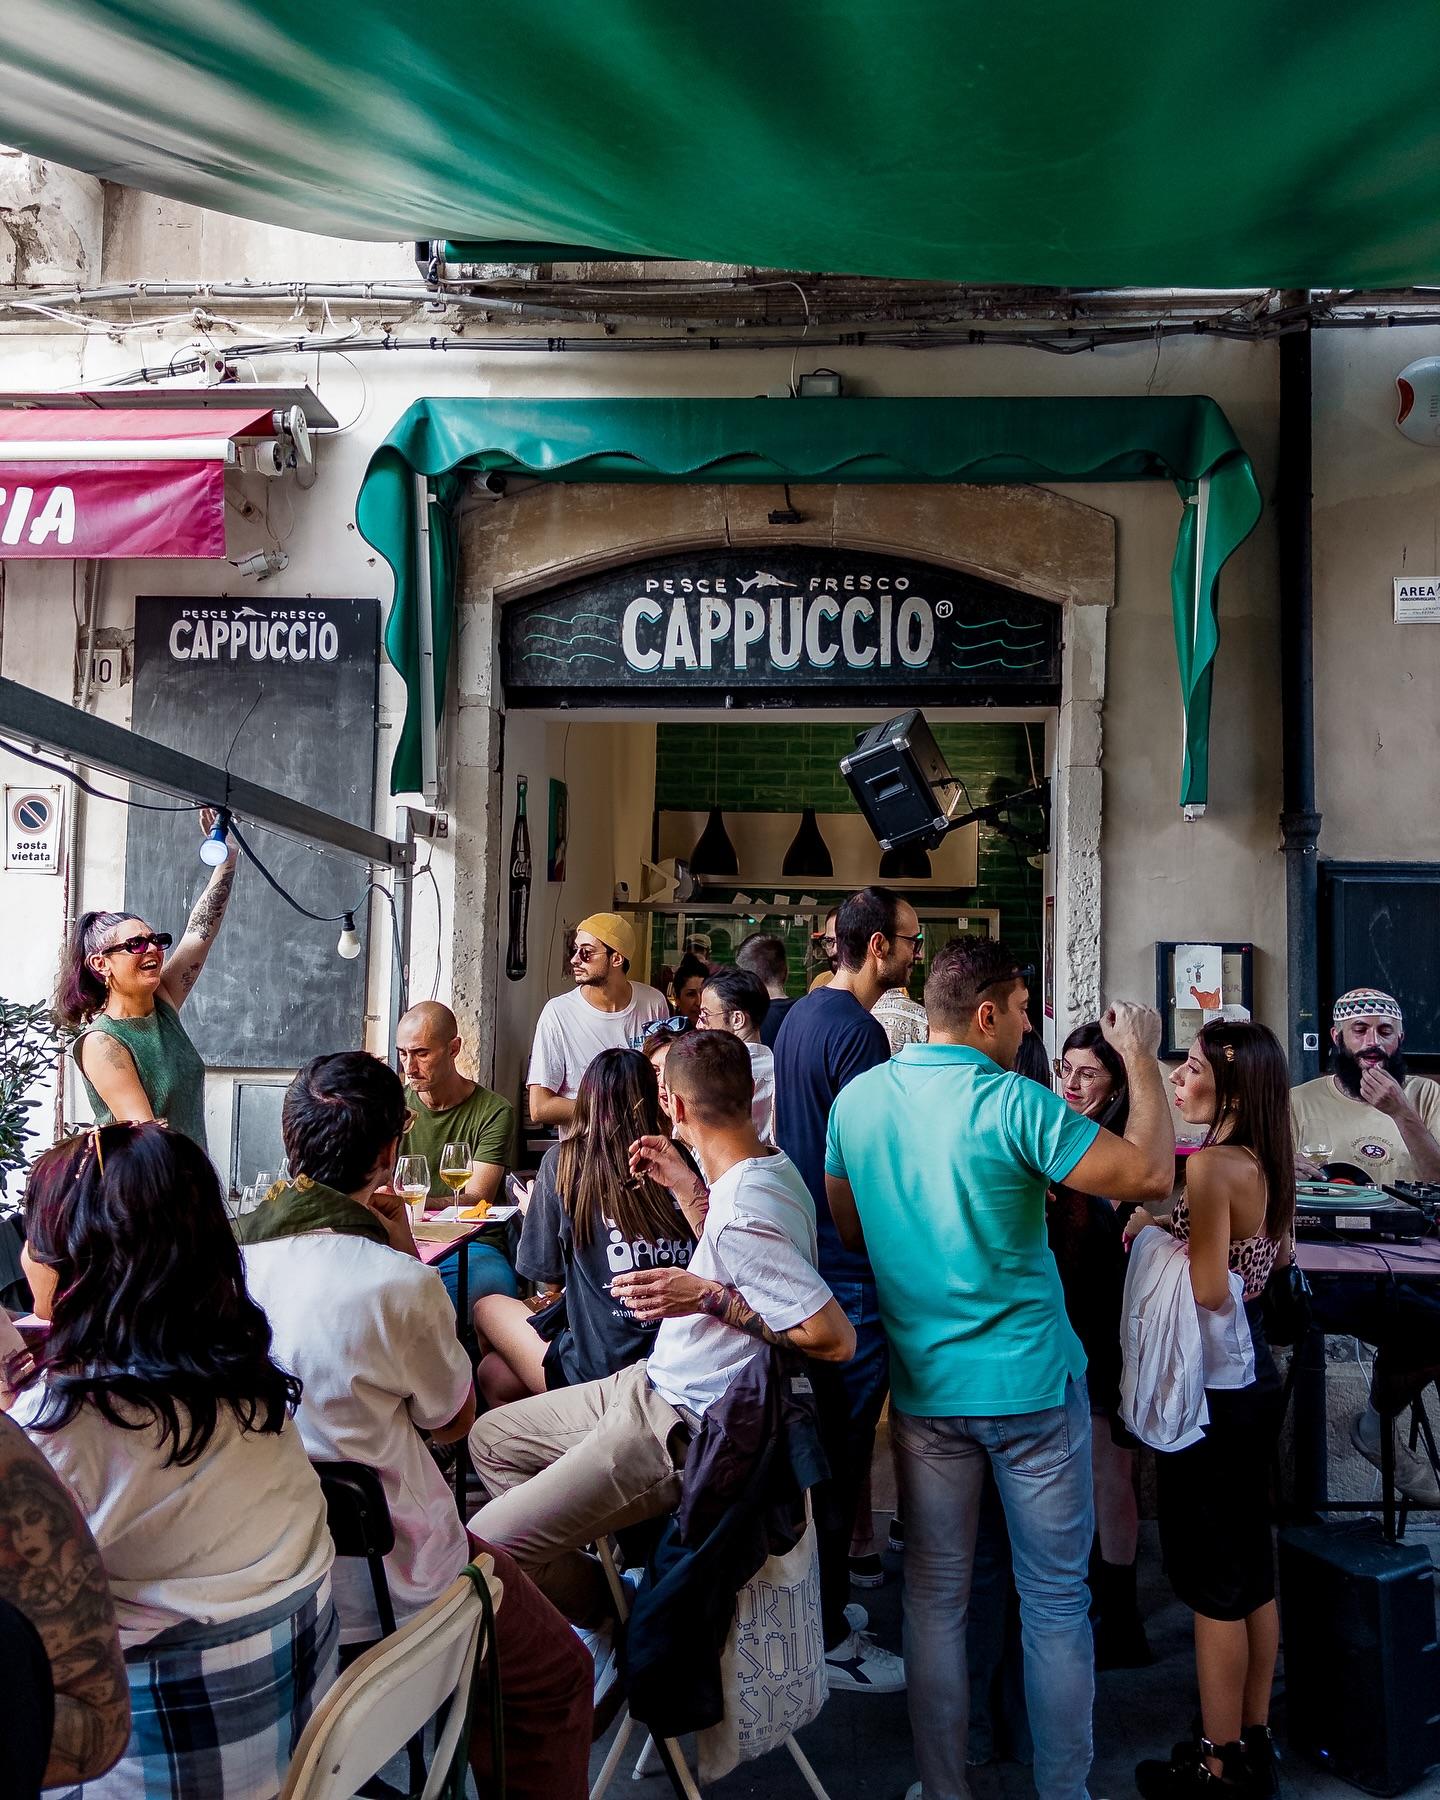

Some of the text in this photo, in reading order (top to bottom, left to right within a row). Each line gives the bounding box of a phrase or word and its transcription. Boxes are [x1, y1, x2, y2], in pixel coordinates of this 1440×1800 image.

[0, 486, 76, 545] IA
[646, 575, 910, 594] PESCE FRESCO
[1400, 586, 1435, 597] AREA
[182, 610, 327, 620] PESCE FRESCO
[622, 595, 934, 671] CAPPUCCIO
[168, 620, 339, 662] CAPPUCCIO
[16, 841, 48, 850] sosta
[11, 851, 51, 861] vietata
